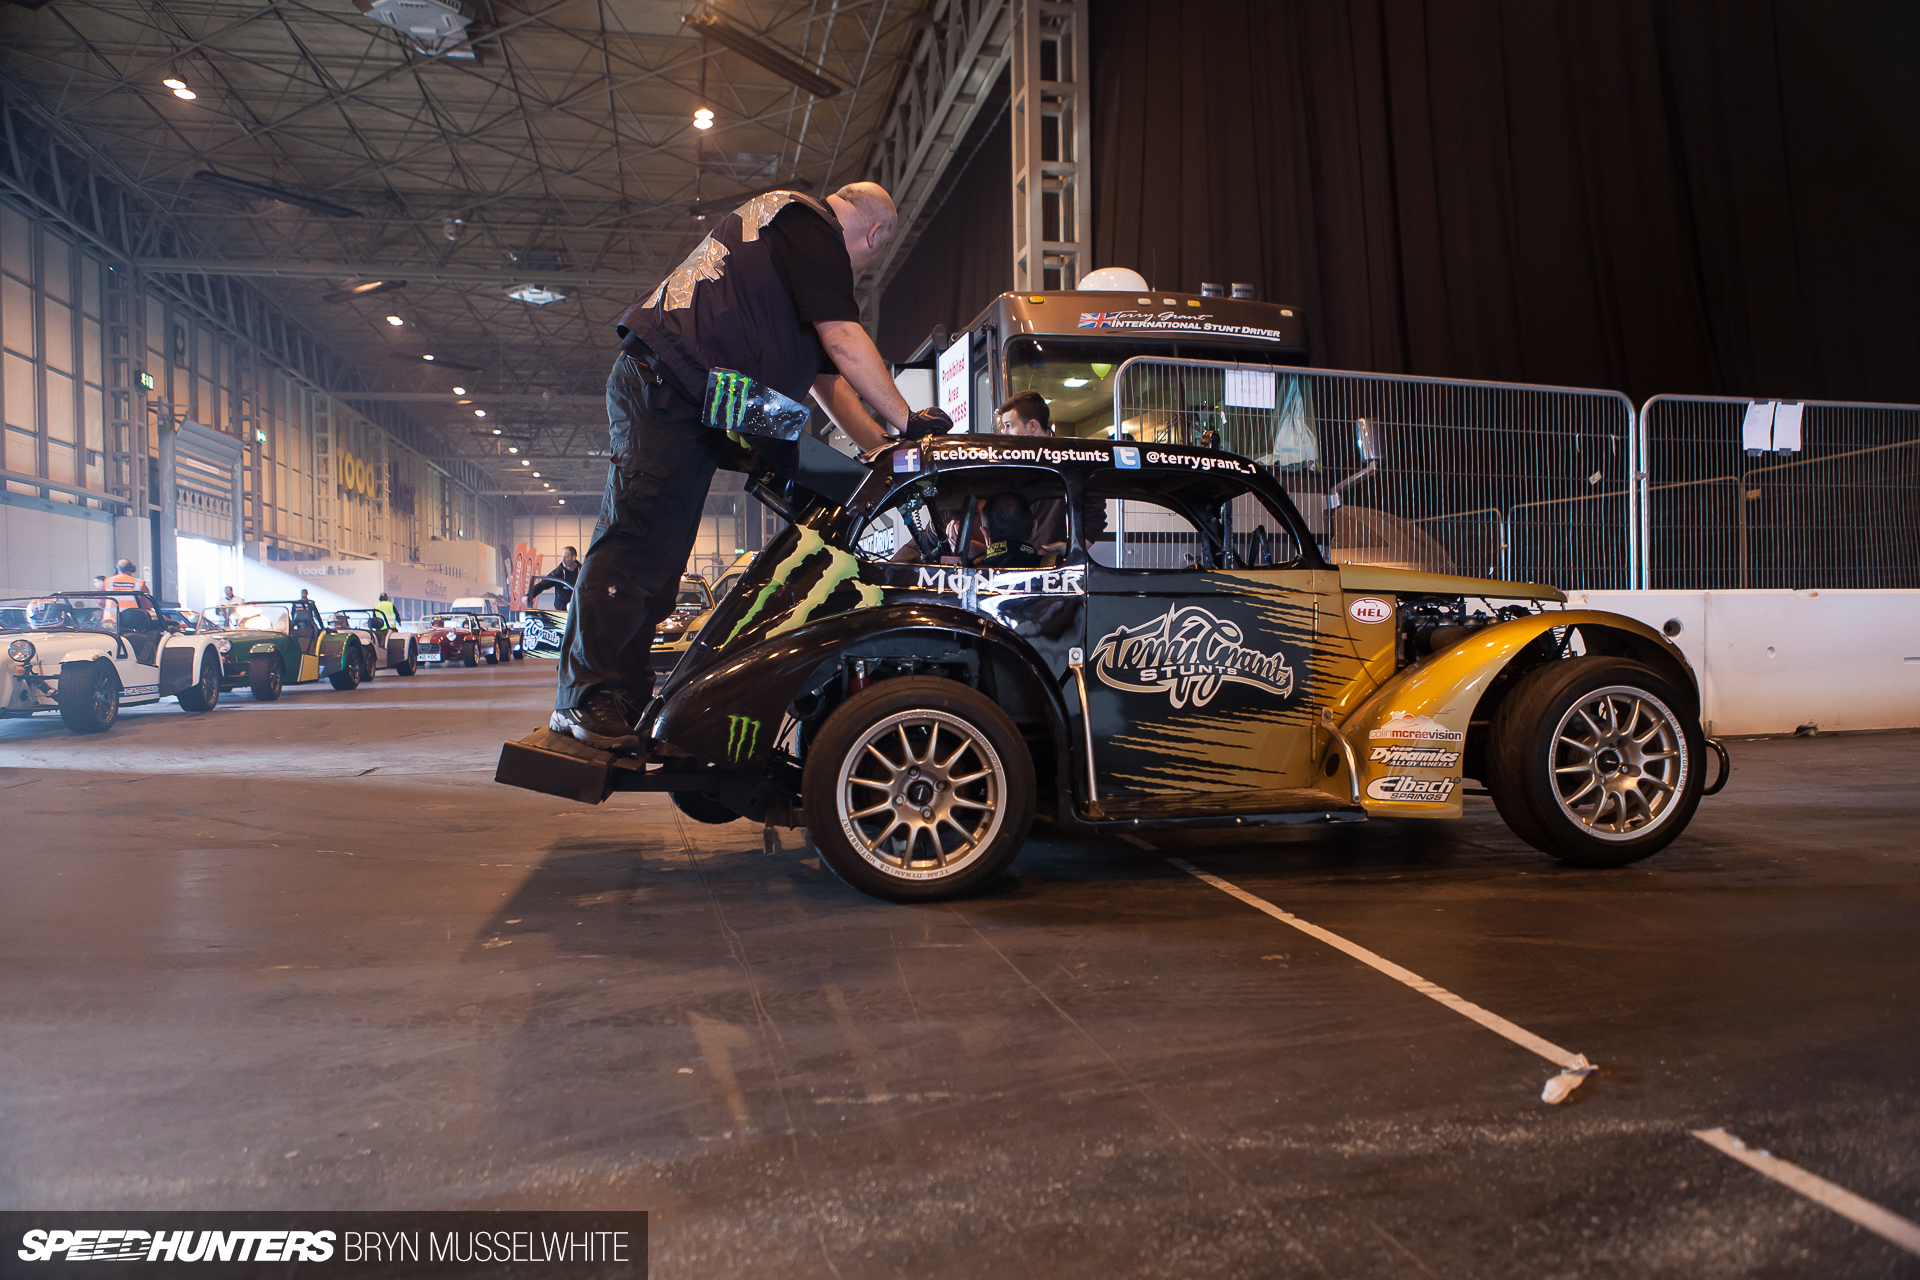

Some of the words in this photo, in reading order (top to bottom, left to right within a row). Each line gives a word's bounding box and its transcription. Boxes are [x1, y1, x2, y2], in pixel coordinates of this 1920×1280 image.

[1111, 319, 1202, 331] INTERNATIONAL
[1203, 322, 1241, 334] STUNT
[1242, 326, 1281, 338] DRIVER
[948, 386, 959, 404] Area
[1146, 451, 1257, 474] @terrygrant_1
[298, 564, 325, 576] food
[337, 564, 356, 576] bar
[1356, 607, 1384, 618] HEL
[1139, 664, 1238, 682] STUNTS
[124, 686, 159, 696] CATERHAM
[1370, 729, 1462, 741] colinmcraevision
[1369, 747, 1461, 764] Dynamics
[1390, 793, 1443, 801] SPRINGS
[840, 816, 878, 864] MOTORSPORT
[878, 862, 922, 879] DYNAMICS
[927, 867, 950, 879] TEAM
